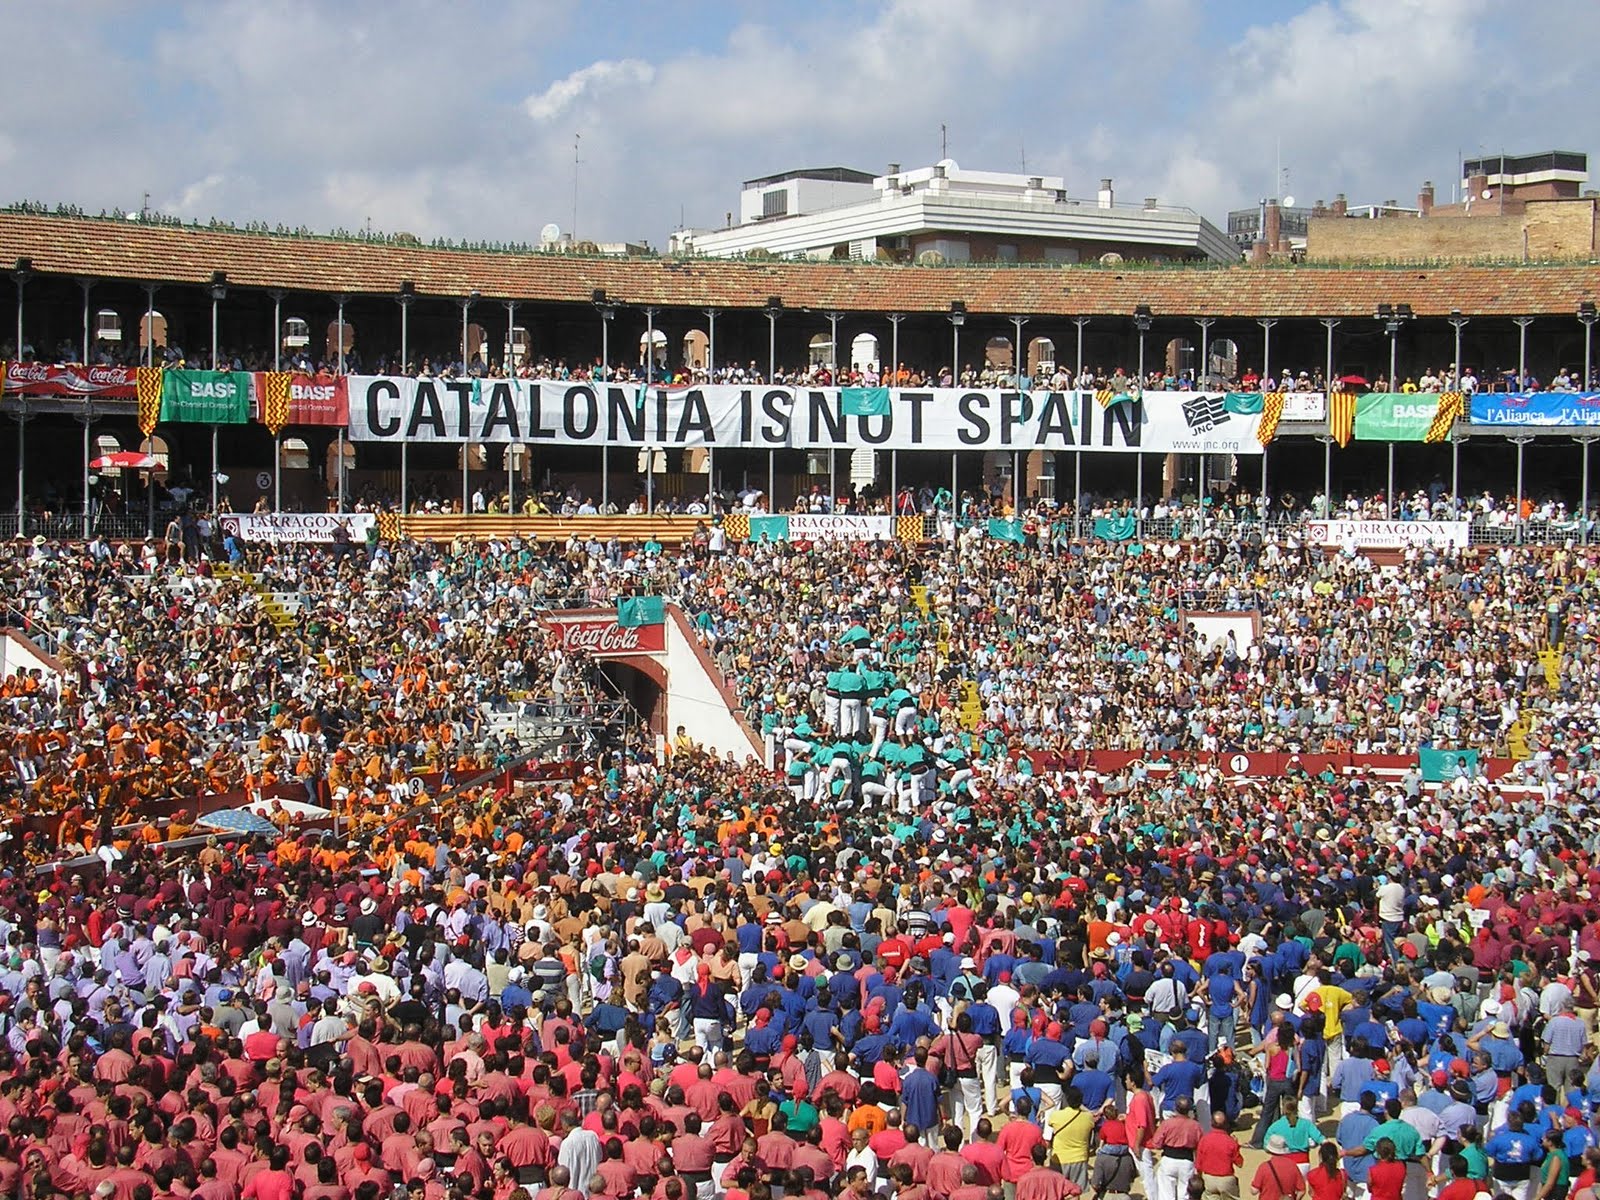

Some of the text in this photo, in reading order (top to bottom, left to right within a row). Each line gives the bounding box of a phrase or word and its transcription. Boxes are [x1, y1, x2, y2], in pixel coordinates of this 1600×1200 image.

[191, 382, 236, 398] BASF
[291, 384, 335, 400] BASF
[366, 381, 716, 443] CATALONIA
[740, 390, 793, 443] IS
[957, 392, 1142, 447] SPAIN
[1192, 423, 1213, 436] JNC
[787, 516, 869, 528] RRAGONA
[1335, 523, 1446, 534] TARRAGONA
